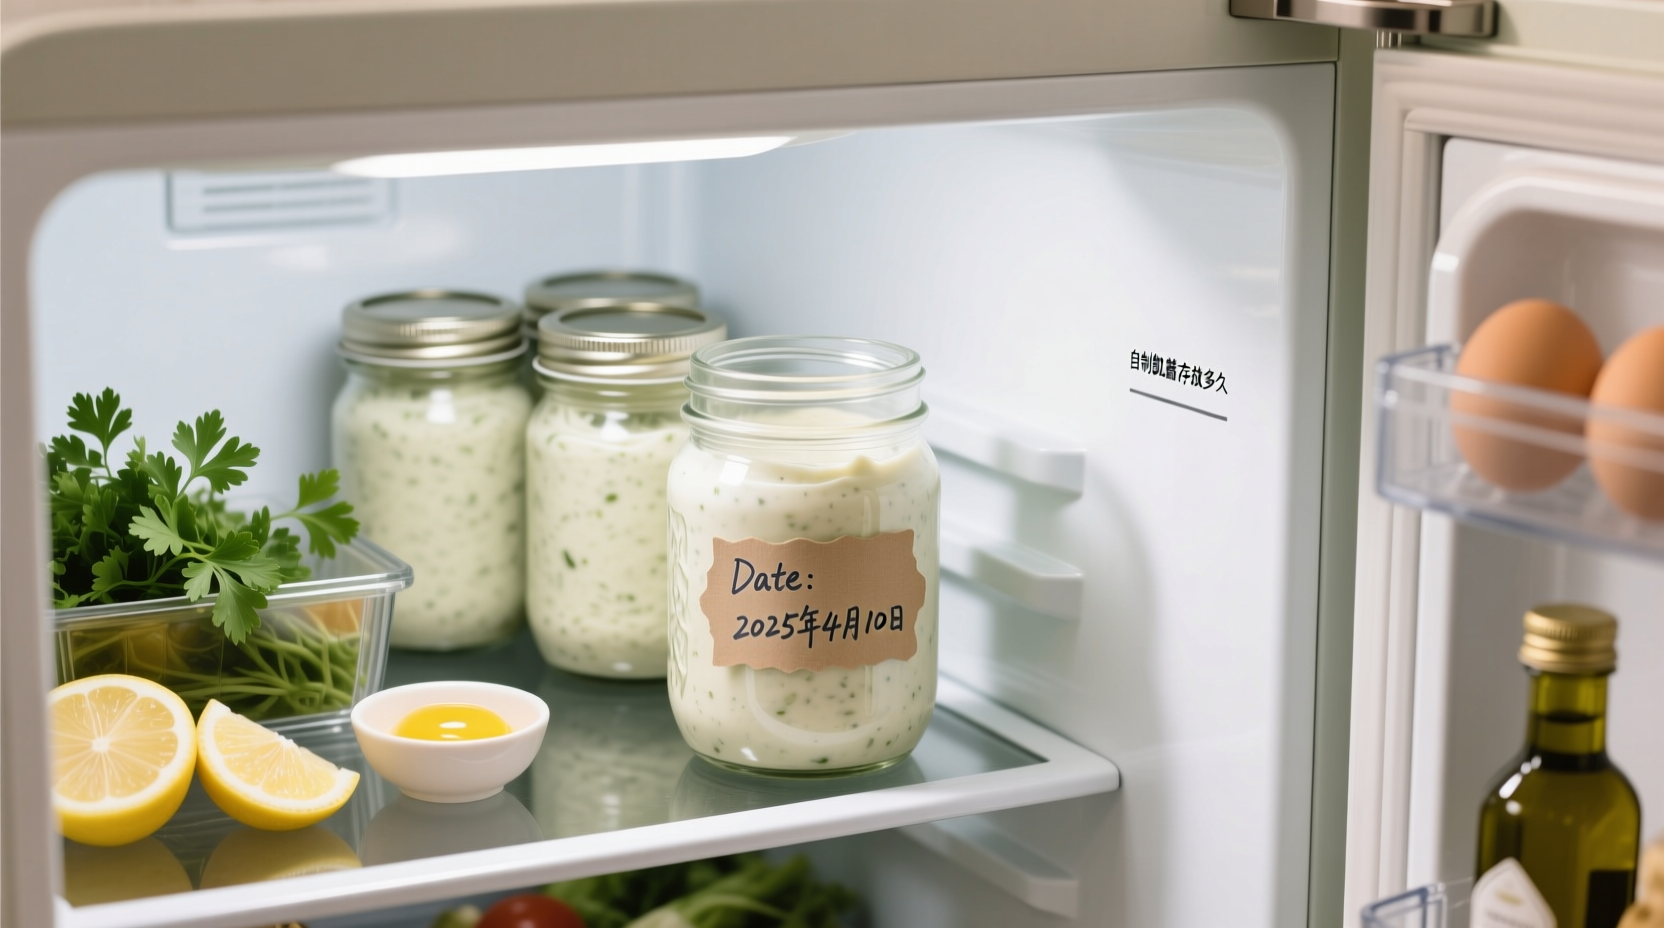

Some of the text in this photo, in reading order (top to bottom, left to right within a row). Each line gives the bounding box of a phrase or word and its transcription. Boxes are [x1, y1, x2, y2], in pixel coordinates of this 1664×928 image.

[731, 557, 814, 596] Date:
[732, 604, 904, 649] 2025年4月10日
